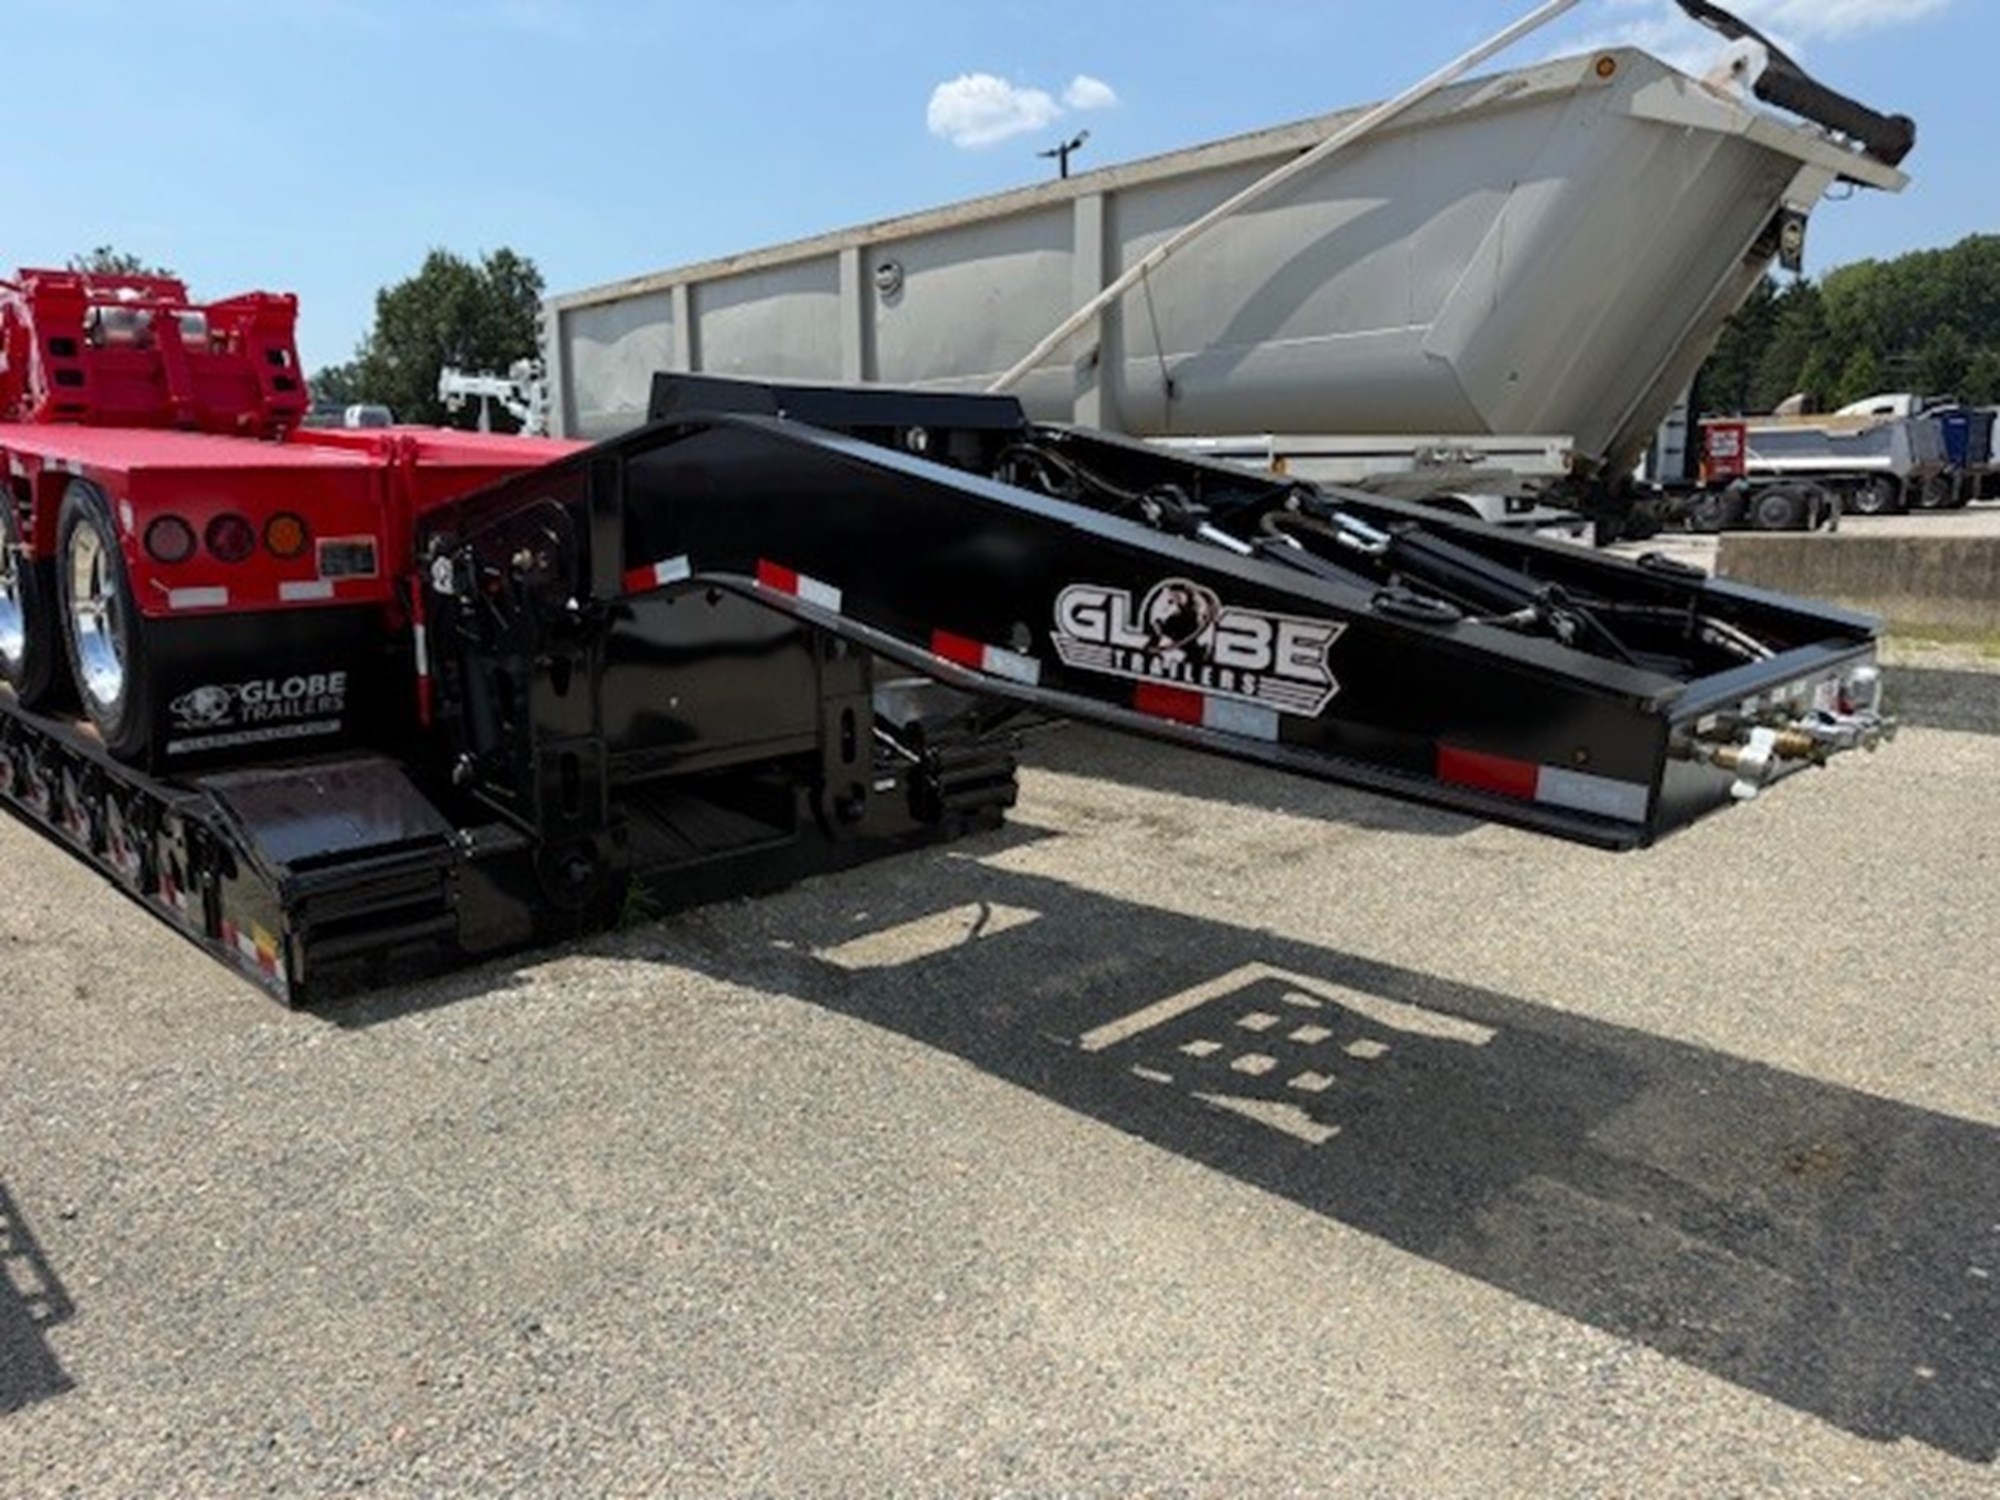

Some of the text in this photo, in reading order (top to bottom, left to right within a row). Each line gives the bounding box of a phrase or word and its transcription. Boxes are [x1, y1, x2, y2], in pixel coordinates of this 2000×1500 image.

[1057, 582, 1332, 683] GLOBE
[240, 672, 347, 703] GLOBE
[1112, 651, 1260, 695] TRAILERS
[241, 697, 345, 722] TRAILERS
